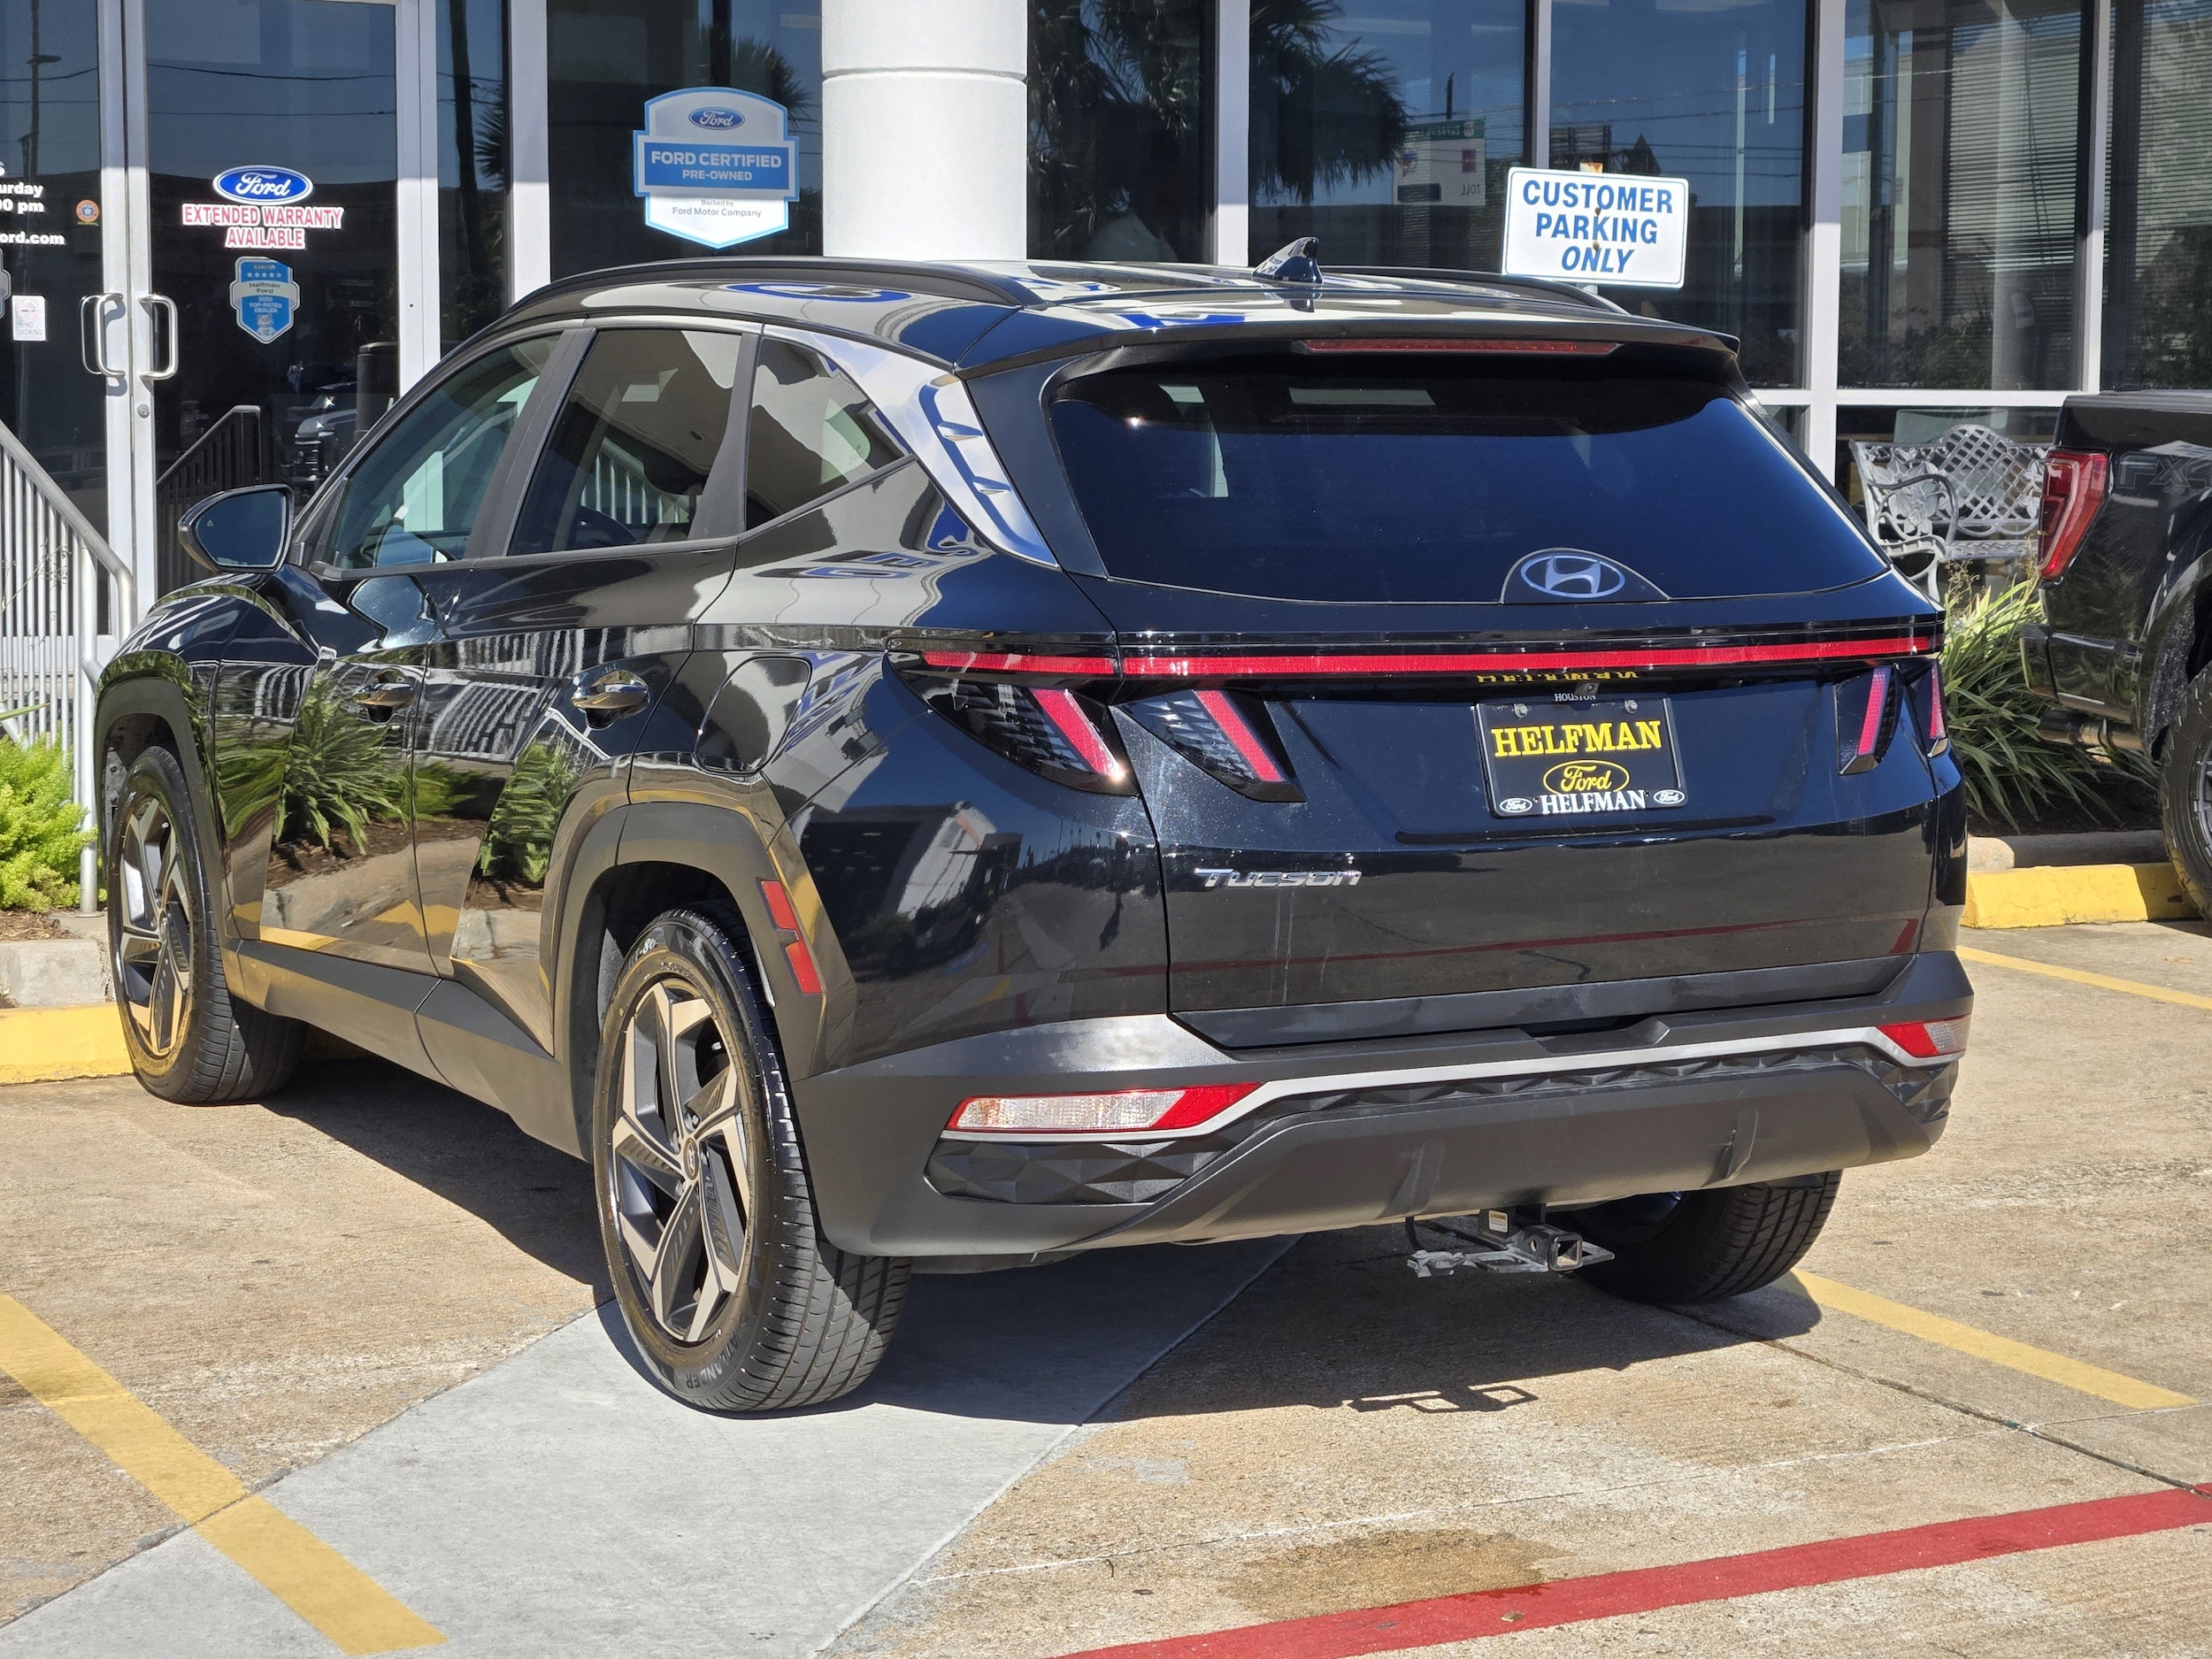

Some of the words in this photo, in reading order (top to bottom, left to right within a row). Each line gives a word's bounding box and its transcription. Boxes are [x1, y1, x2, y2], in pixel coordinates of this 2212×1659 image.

[699, 110, 733, 127] Ford
[651, 150, 696, 165] FORD
[699, 153, 782, 168] CERTIFIED
[234, 172, 292, 197] Ford
[682, 169, 752, 181] PRE-OWNED
[18, 202, 44, 214] pm
[1523, 179, 1673, 214] CUSTOMER
[183, 204, 260, 226] EXTENDED
[262, 205, 343, 227] WARRANTY
[672, 206, 692, 216] Ford
[694, 207, 719, 217] Motor
[721, 208, 762, 219] Company
[227, 227, 304, 248] AVAILABLE
[1535, 211, 1658, 244] PARKING
[1561, 244, 1635, 274] ONLY
[1490, 719, 1663, 757] HELFMAN
[1560, 764, 1613, 792] Ford
[1539, 788, 1647, 815] HELFMAN
